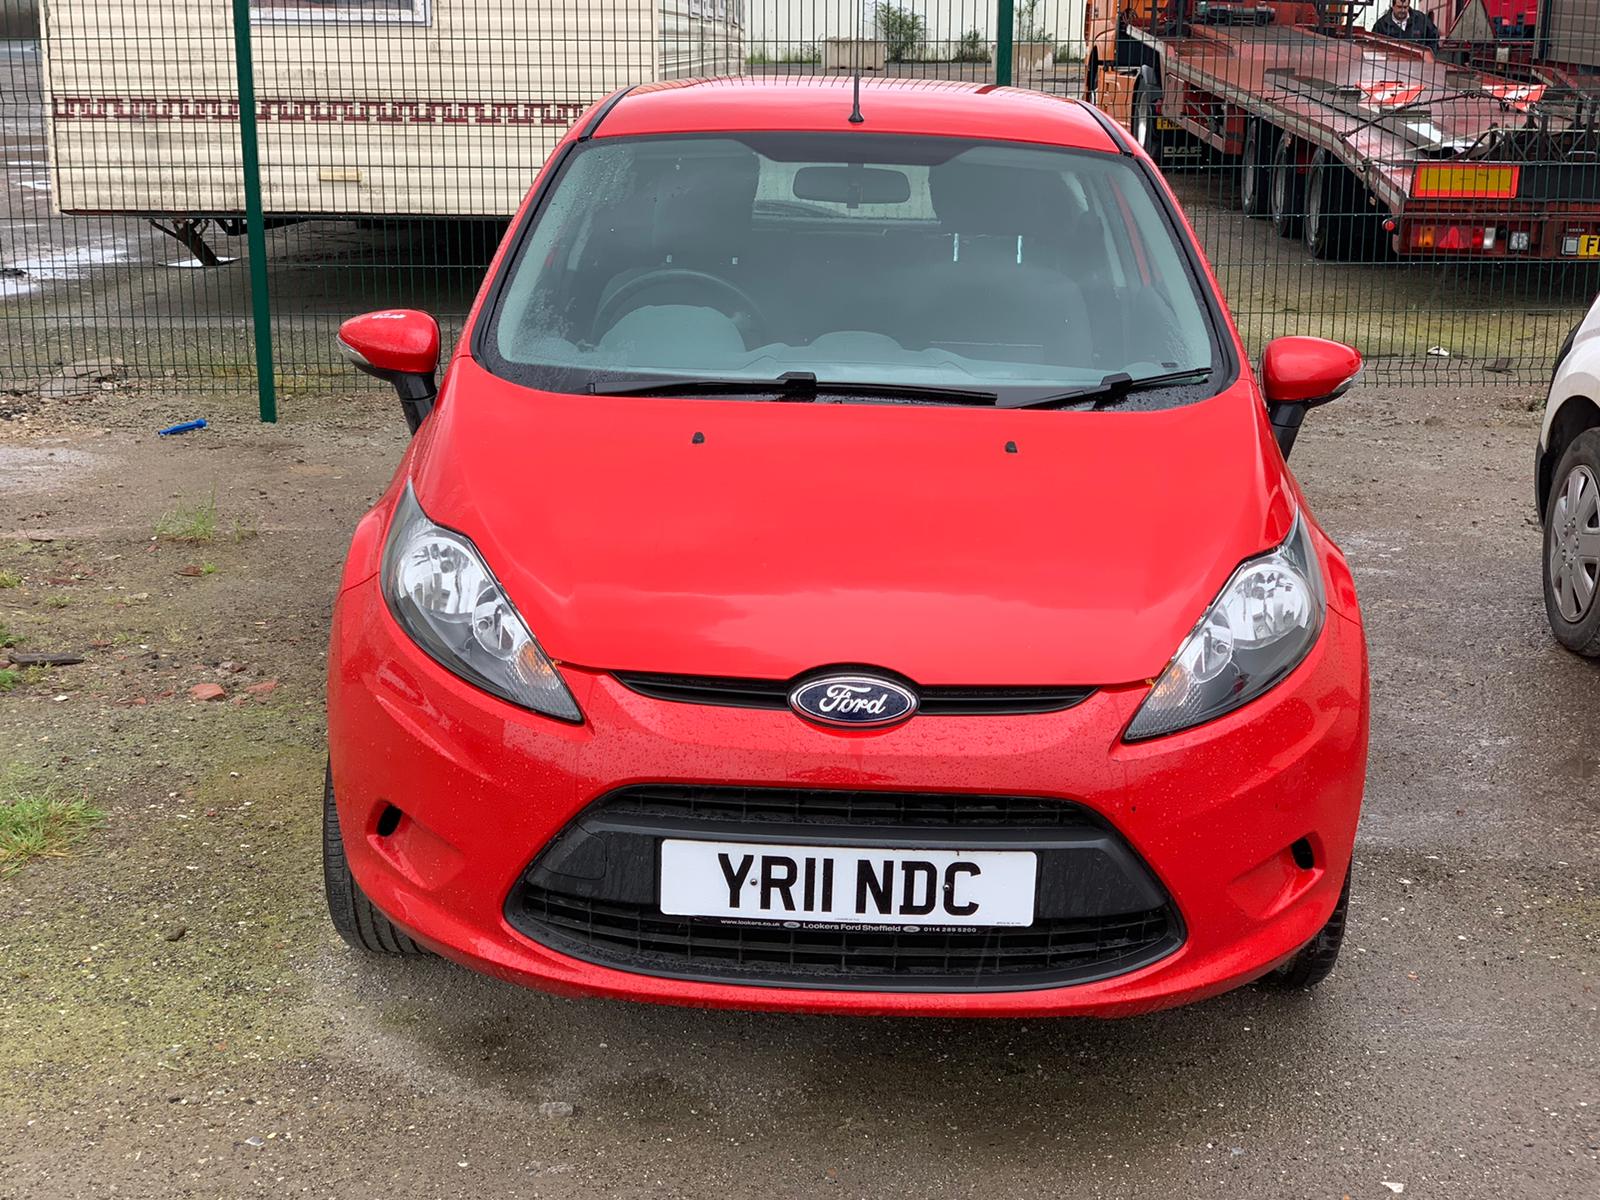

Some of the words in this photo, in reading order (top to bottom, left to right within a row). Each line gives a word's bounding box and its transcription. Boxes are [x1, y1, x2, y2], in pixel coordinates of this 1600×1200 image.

[1163, 146, 1202, 154] DAF
[819, 684, 888, 714] Ford
[717, 853, 833, 913] YR11
[855, 859, 982, 916] NDC
[720, 919, 780, 927] www.lookers.co.uk
[802, 922, 839, 930] Lookers
